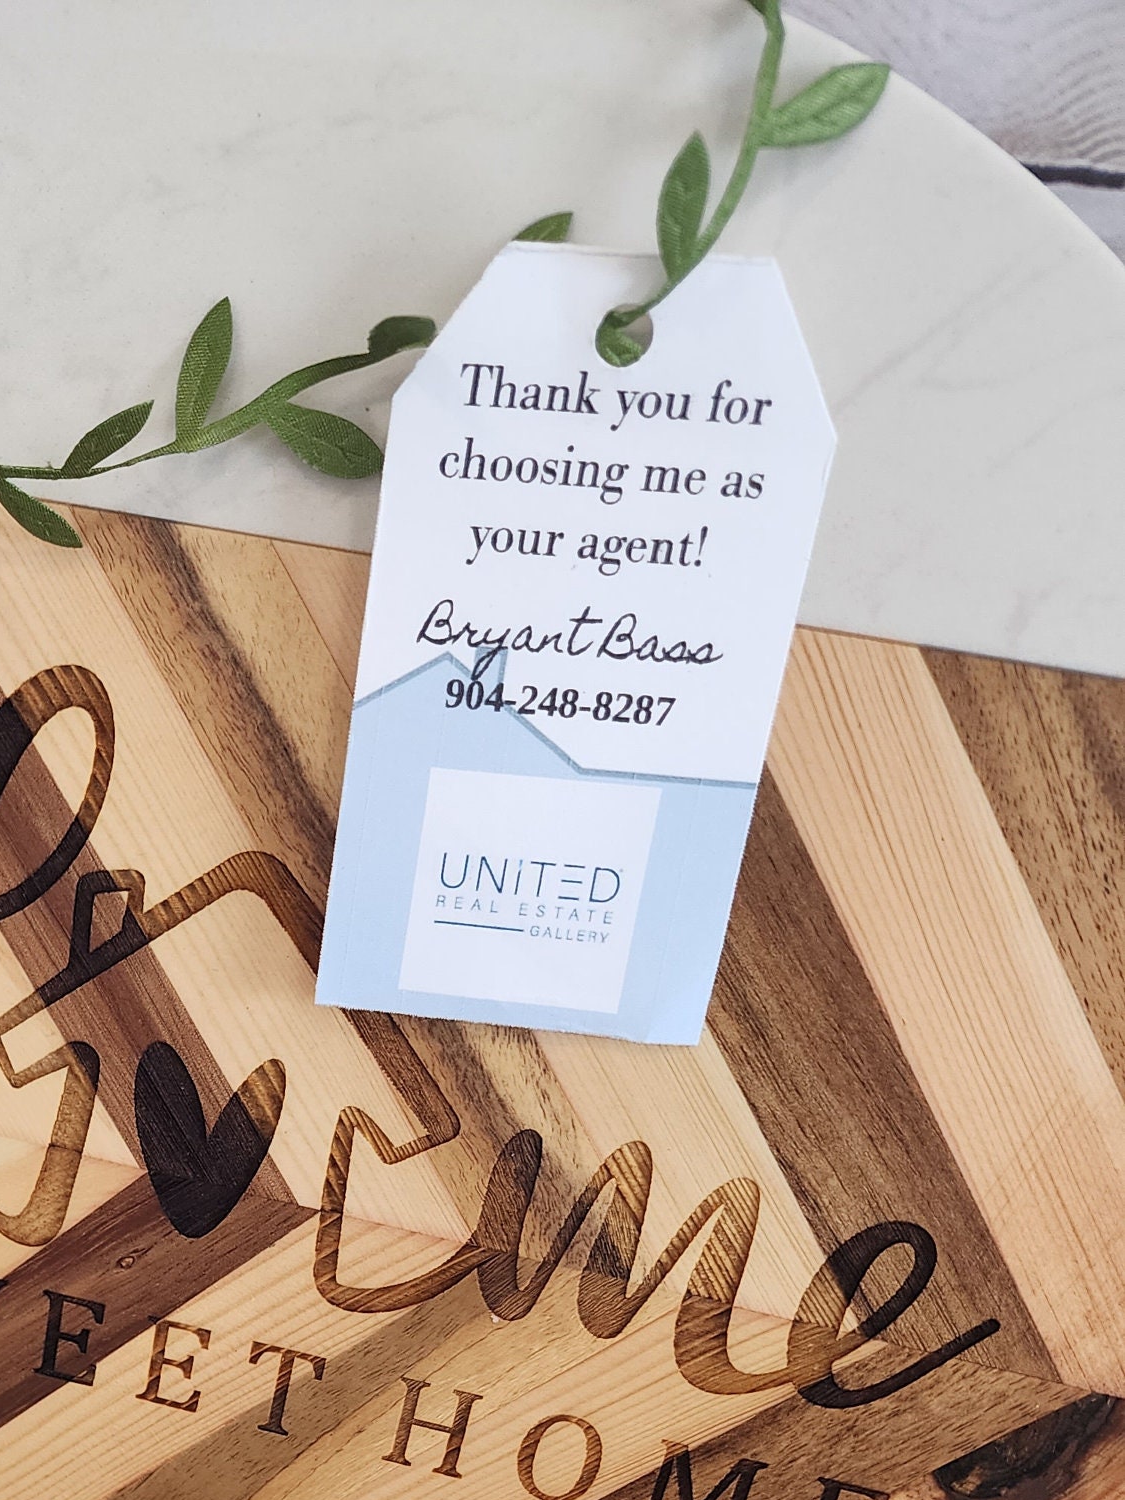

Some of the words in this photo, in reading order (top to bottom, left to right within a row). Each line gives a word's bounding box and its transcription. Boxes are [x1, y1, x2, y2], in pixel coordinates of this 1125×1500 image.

[461, 363, 600, 414] Thank
[610, 389, 690, 431] you
[706, 379, 772, 425] for
[439, 437, 629, 505] choosing
[640, 463, 707, 495] me
[720, 470, 765, 499] as
[466, 524, 564, 566] your
[577, 526, 708, 577] agent!
[416, 599, 602, 681] Bryant
[597, 613, 723, 664] Bass
[445, 679, 676, 727] 904-248-8287
[436, 894, 499, 914] REAL
[519, 903, 614, 925] ESTATE
[529, 925, 610, 944] GALLERY
